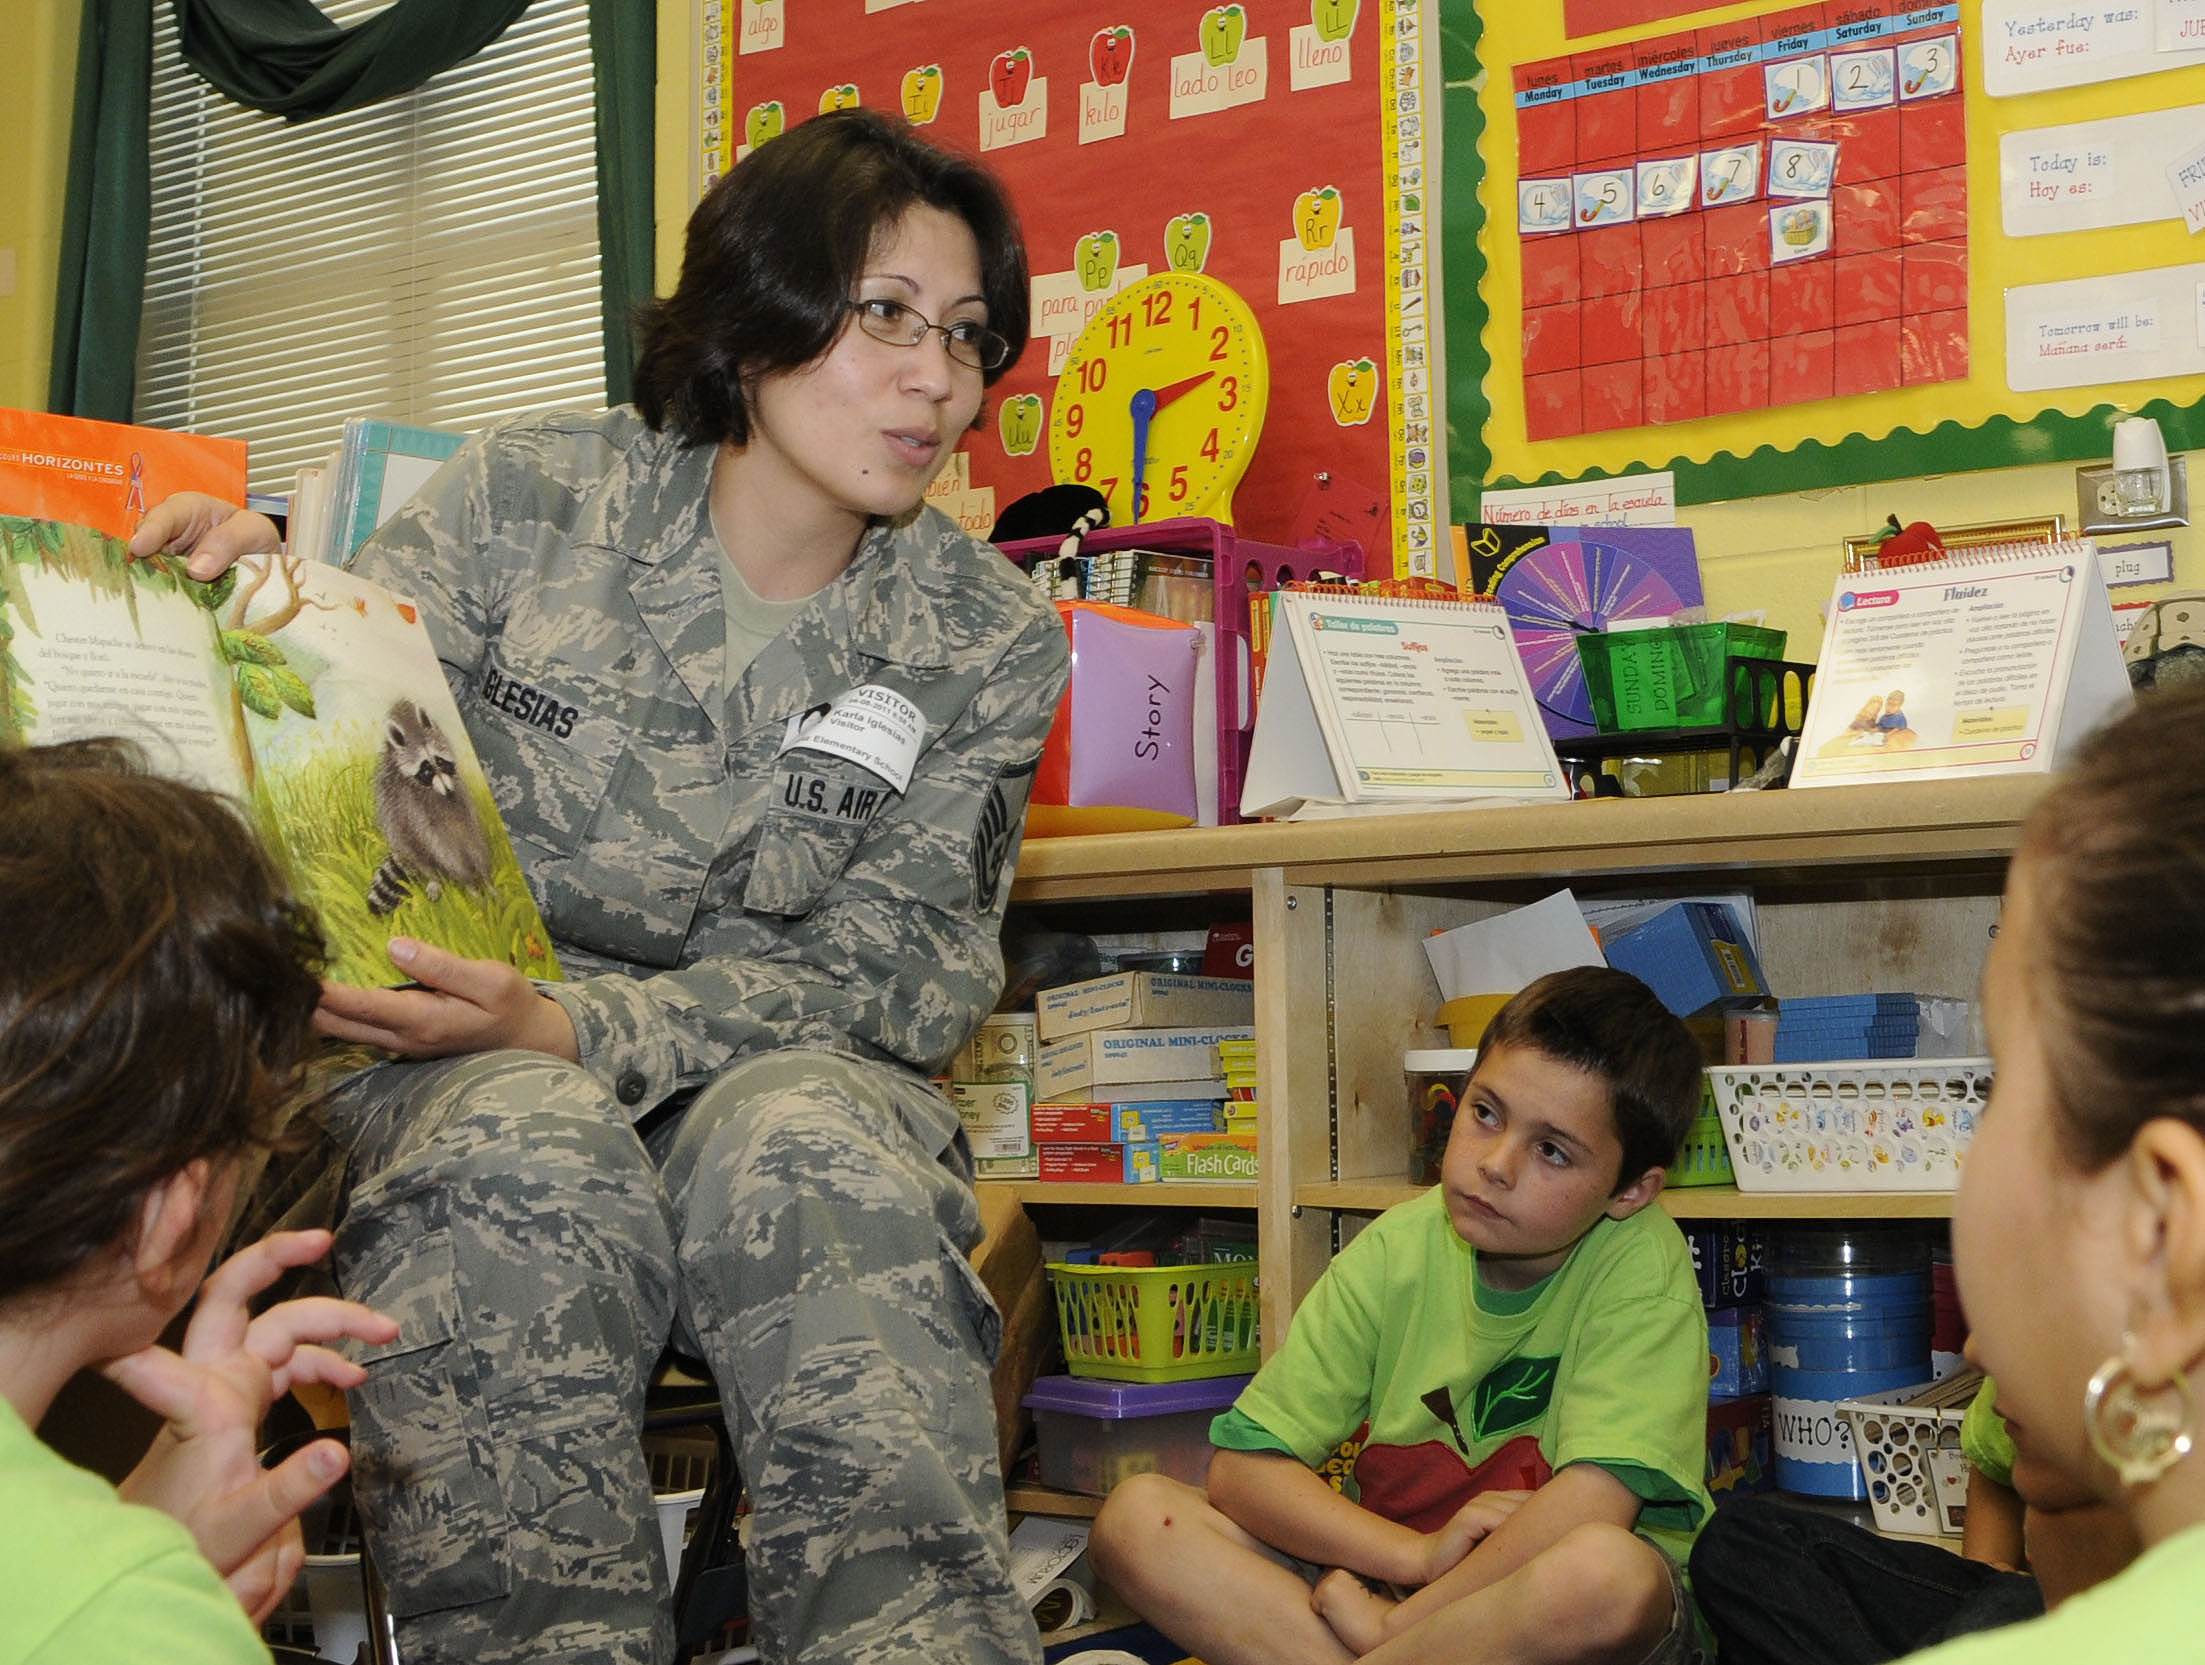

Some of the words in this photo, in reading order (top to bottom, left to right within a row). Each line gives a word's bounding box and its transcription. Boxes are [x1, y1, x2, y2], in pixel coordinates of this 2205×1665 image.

[747, 7, 778, 45] algo
[1771, 20, 1816, 39] viernes
[1836, 21, 1882, 40] Saturday
[1906, 10, 1944, 26] Sunday
[2004, 13, 2094, 37] Yesterday
[2104, 8, 2139, 24] was:
[1299, 36, 1343, 69] lleno
[1710, 33, 1749, 54] jueves
[1777, 38, 1809, 53] Friday
[2005, 45, 2046, 66] Ayer
[2056, 39, 2089, 56] fue:
[1639, 62, 1695, 81] Wednesday
[1706, 50, 1753, 68] Thursday
[1927, 47, 1938, 73] 3
[1174, 63, 1219, 99] lado
[1228, 66, 1257, 92] leo
[1585, 75, 1625, 91] Tuesday
[1795, 68, 1800, 90] 1
[1848, 64, 1868, 90] 2
[1085, 91, 1120, 126] kilo
[1525, 87, 1563, 103] Monday
[985, 106, 1041, 148] jugar
[1727, 159, 1741, 184] 7
[1785, 154, 1801, 179] 8
[2030, 153, 2078, 173] Today
[2087, 151, 2107, 167] is:
[1603, 182, 1618, 205] 5
[1651, 173, 1665, 197] 6
[2030, 180, 2060, 201] Hoy
[2068, 182, 2093, 196] es:
[1533, 191, 1545, 218] 4
[1305, 218, 1328, 244] Rr
[1085, 259, 1107, 288] Pp
[1286, 243, 1349, 287] rápido
[1041, 296, 1079, 327] para
[1142, 290, 1173, 327] 12
[1187, 296, 1200, 331] 1
[1106, 312, 1133, 349] 11
[2039, 322, 2101, 338] Tomorrow
[2108, 315, 2128, 331] will
[2135, 314, 2154, 328] be:
[1209, 325, 1229, 362] 2
[2039, 339, 2089, 357] Mañana
[1076, 357, 1107, 394] 10
[1217, 375, 1238, 412] 3
[1337, 390, 1367, 417] Xx
[1066, 403, 1084, 439] 9
[1199, 427, 1220, 462] 4
[22, 452, 124, 476] HORIZONTES
[1074, 447, 1092, 483] 8
[1100, 476, 1119, 505] 7
[1168, 465, 1188, 502] 5
[959, 495, 992, 531] todo
[1483, 503, 1530, 525] Número
[1537, 501, 1552, 520] de
[1585, 503, 1600, 515] en
[1608, 493, 1620, 512] la
[1622, 491, 1668, 510] escuela
[2115, 559, 2140, 578] plug
[1943, 586, 1988, 602] Fluidez
[1621, 637, 1641, 714] SUNDAY
[859, 689, 916, 722] VISITOR
[1135, 673, 1170, 761] Story
[830, 718, 865, 733] Visitor
[834, 709, 864, 723] Karla
[867, 716, 906, 745] Iglesias
[813, 735, 872, 761] Elementary
[874, 756, 903, 781] School
[784, 773, 829, 815] U.S.
[836, 786, 878, 821] AIR
[1151, 977, 1194, 990] ORIGINAL
[1197, 980, 1252, 993] MINI-CLOCKS
[1103, 1036, 1165, 1050] ORIGINAL
[1187, 1153, 1221, 1176] Flash
[1224, 1154, 1258, 1176] Cards
[1778, 1412, 1850, 1450] WHO?
